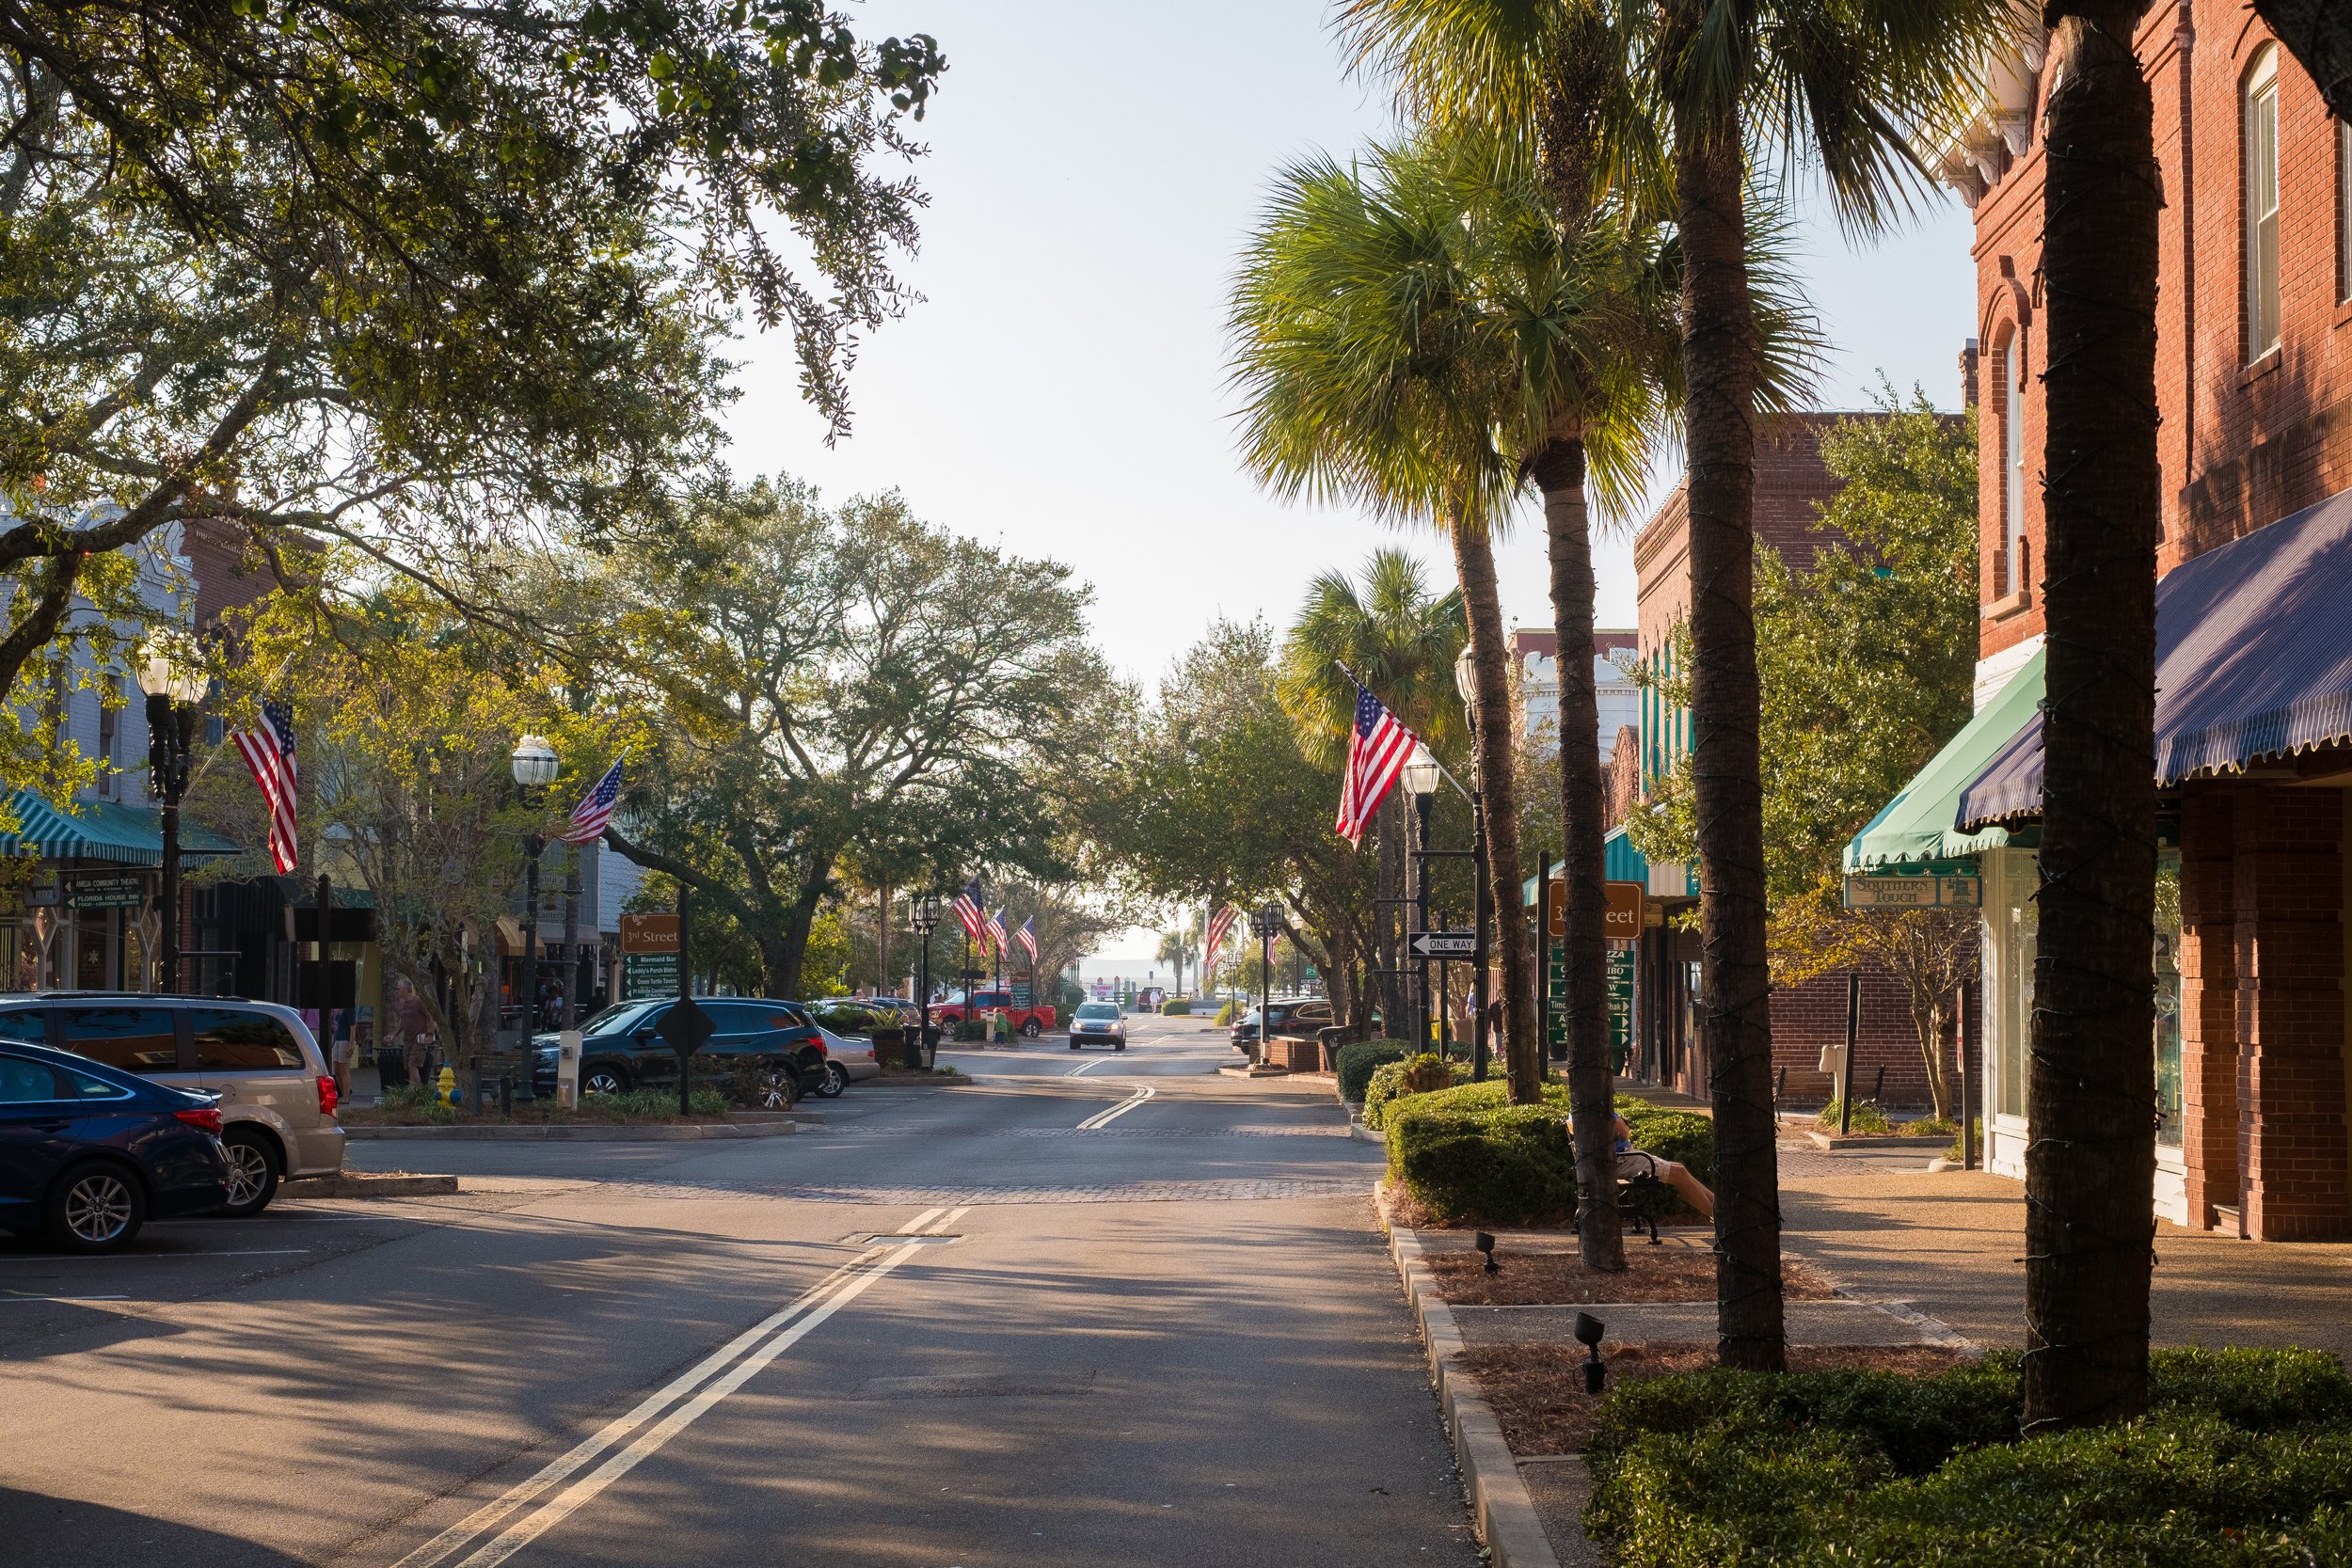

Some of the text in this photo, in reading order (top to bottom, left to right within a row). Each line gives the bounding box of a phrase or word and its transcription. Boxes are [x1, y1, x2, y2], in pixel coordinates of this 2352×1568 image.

[1856, 879, 1929, 891] SOUTHERN
[1873, 890, 1917, 903] TOUCH
[627, 931, 678, 942] 3rd Street
[1430, 940, 1472, 949] ONE WAY
